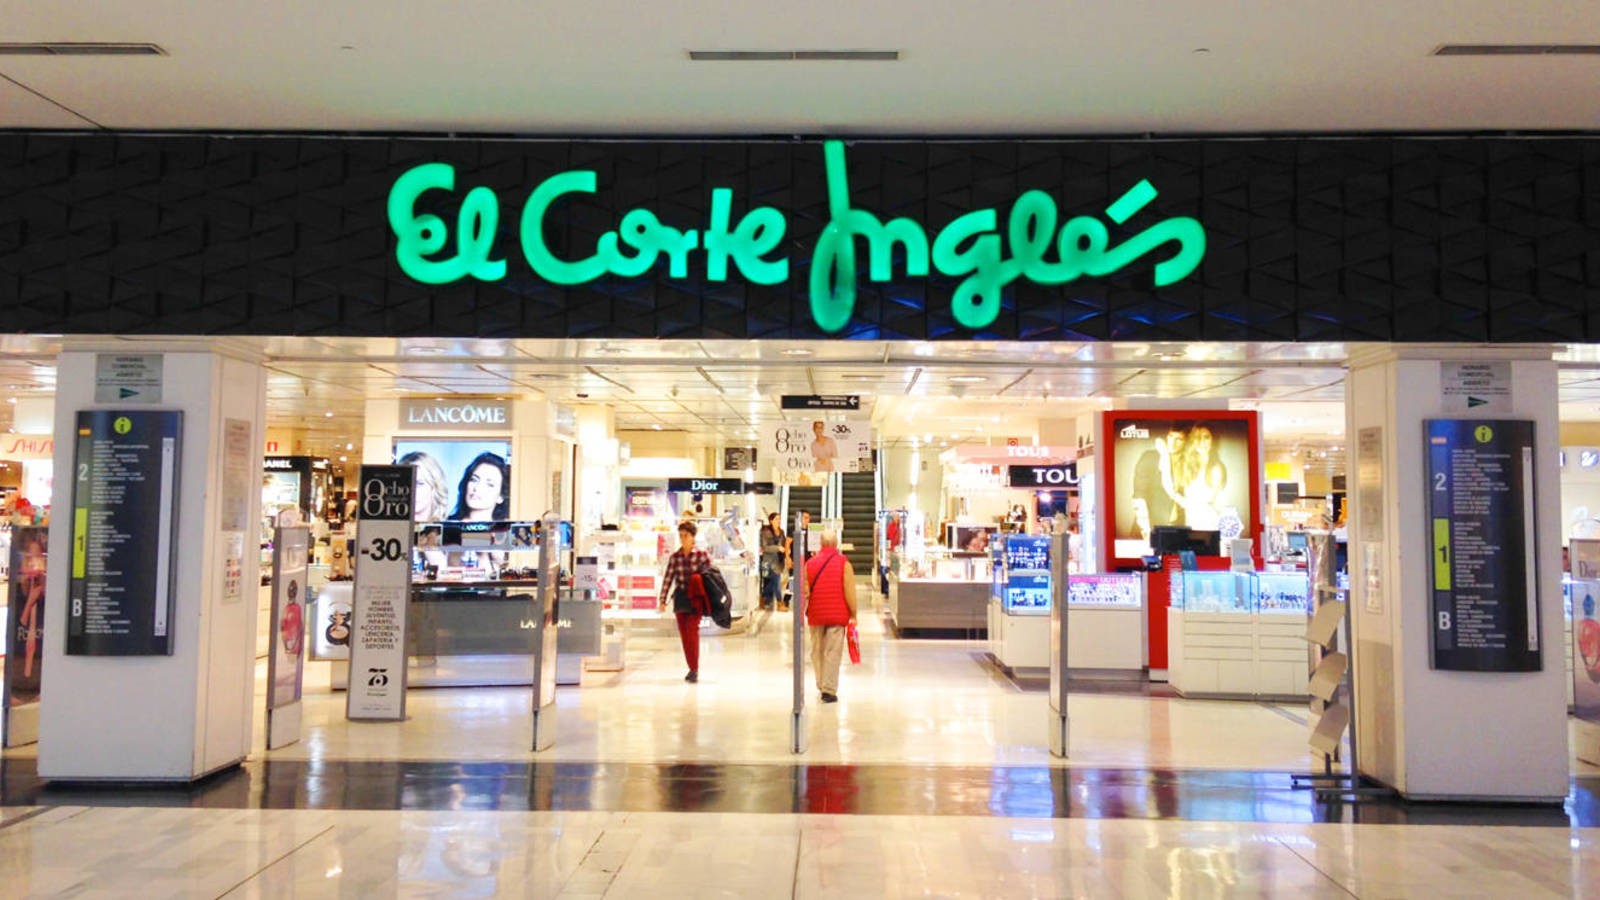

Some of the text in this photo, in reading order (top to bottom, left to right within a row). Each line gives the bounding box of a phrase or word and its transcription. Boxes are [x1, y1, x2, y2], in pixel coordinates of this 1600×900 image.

[388, 140, 1206, 332] El Corte Inglés
[407, 404, 506, 423] LANCÔME
[78, 463, 89, 481] 2
[1434, 472, 1447, 491] 2
[365, 478, 409, 501] Ocho
[691, 479, 718, 491] Dior
[363, 494, 409, 517] Oro
[77, 535, 84, 553] 1
[1438, 545, 1447, 563] 1
[72, 599, 83, 617] B
[1438, 611, 1451, 630] B
